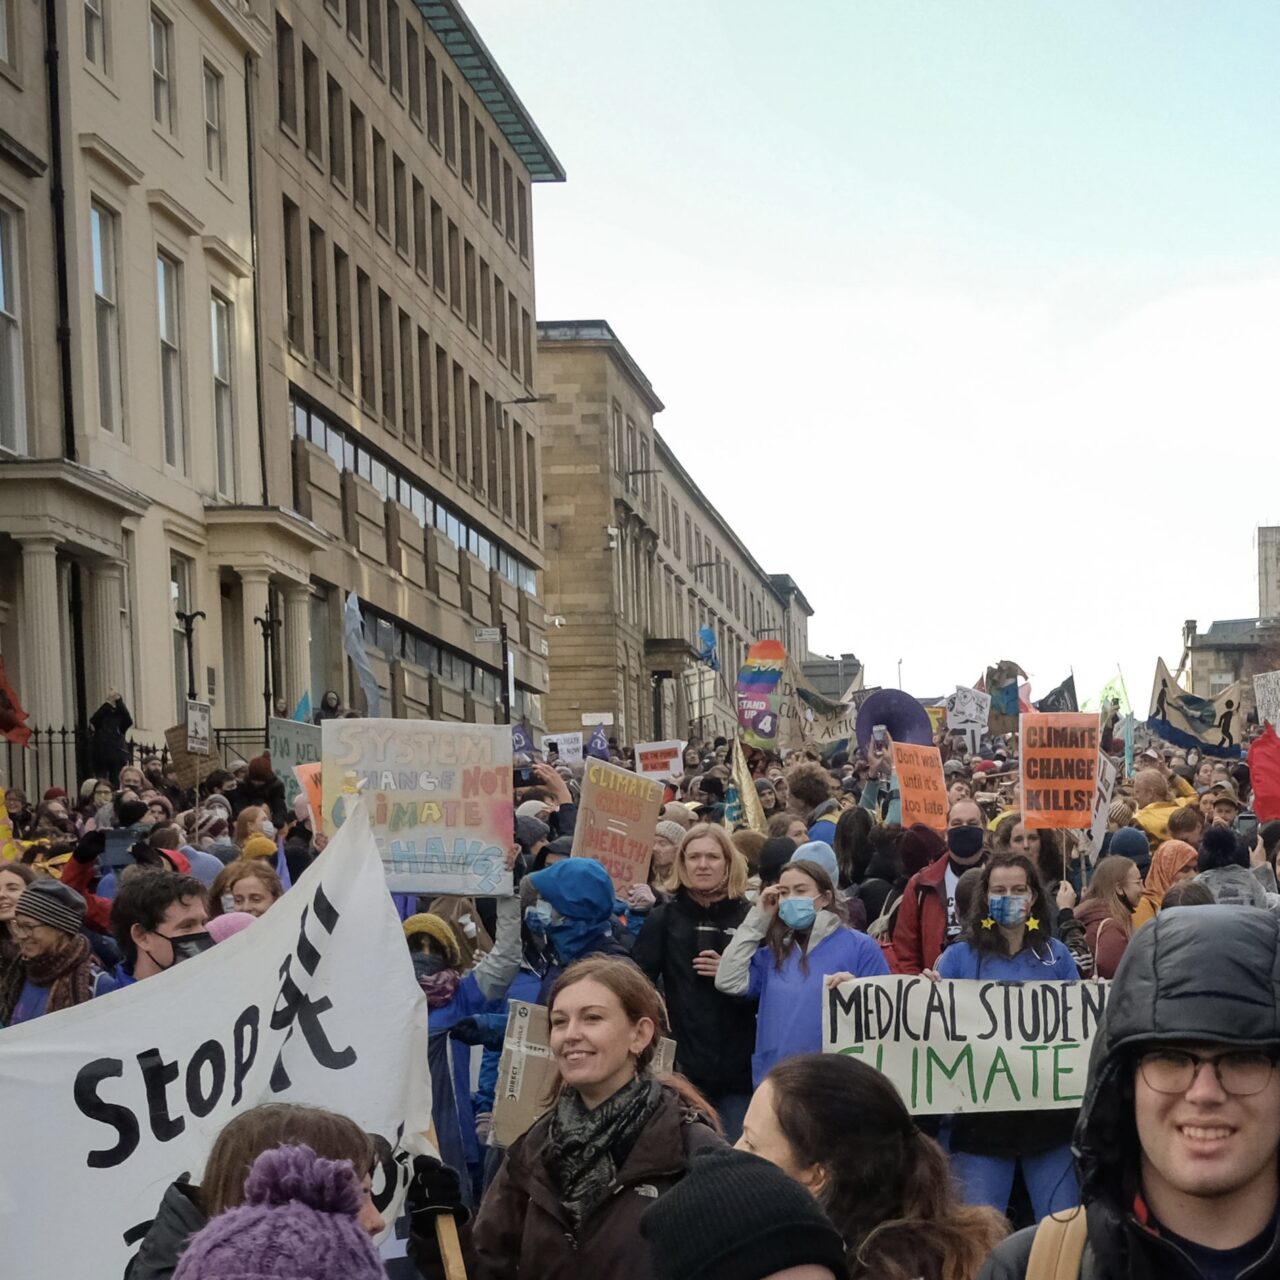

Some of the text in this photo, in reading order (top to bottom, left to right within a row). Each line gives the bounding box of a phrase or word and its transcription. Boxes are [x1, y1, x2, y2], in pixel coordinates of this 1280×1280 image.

[738, 700, 766, 710] STAND
[744, 710, 758, 720] UP
[336, 726, 493, 765] SYSTEM
[1026, 726, 1096, 749] CLIMATE
[1026, 757, 1094, 780] CHANGE
[357, 766, 510, 798] HANGE NOT
[588, 764, 658, 802] CLIMATE
[902, 775, 923, 790] until
[1026, 789, 1092, 811] KILLS!
[828, 978, 1113, 1044] MEDICAL STUDEN
[73, 1004, 260, 1169] Stop
